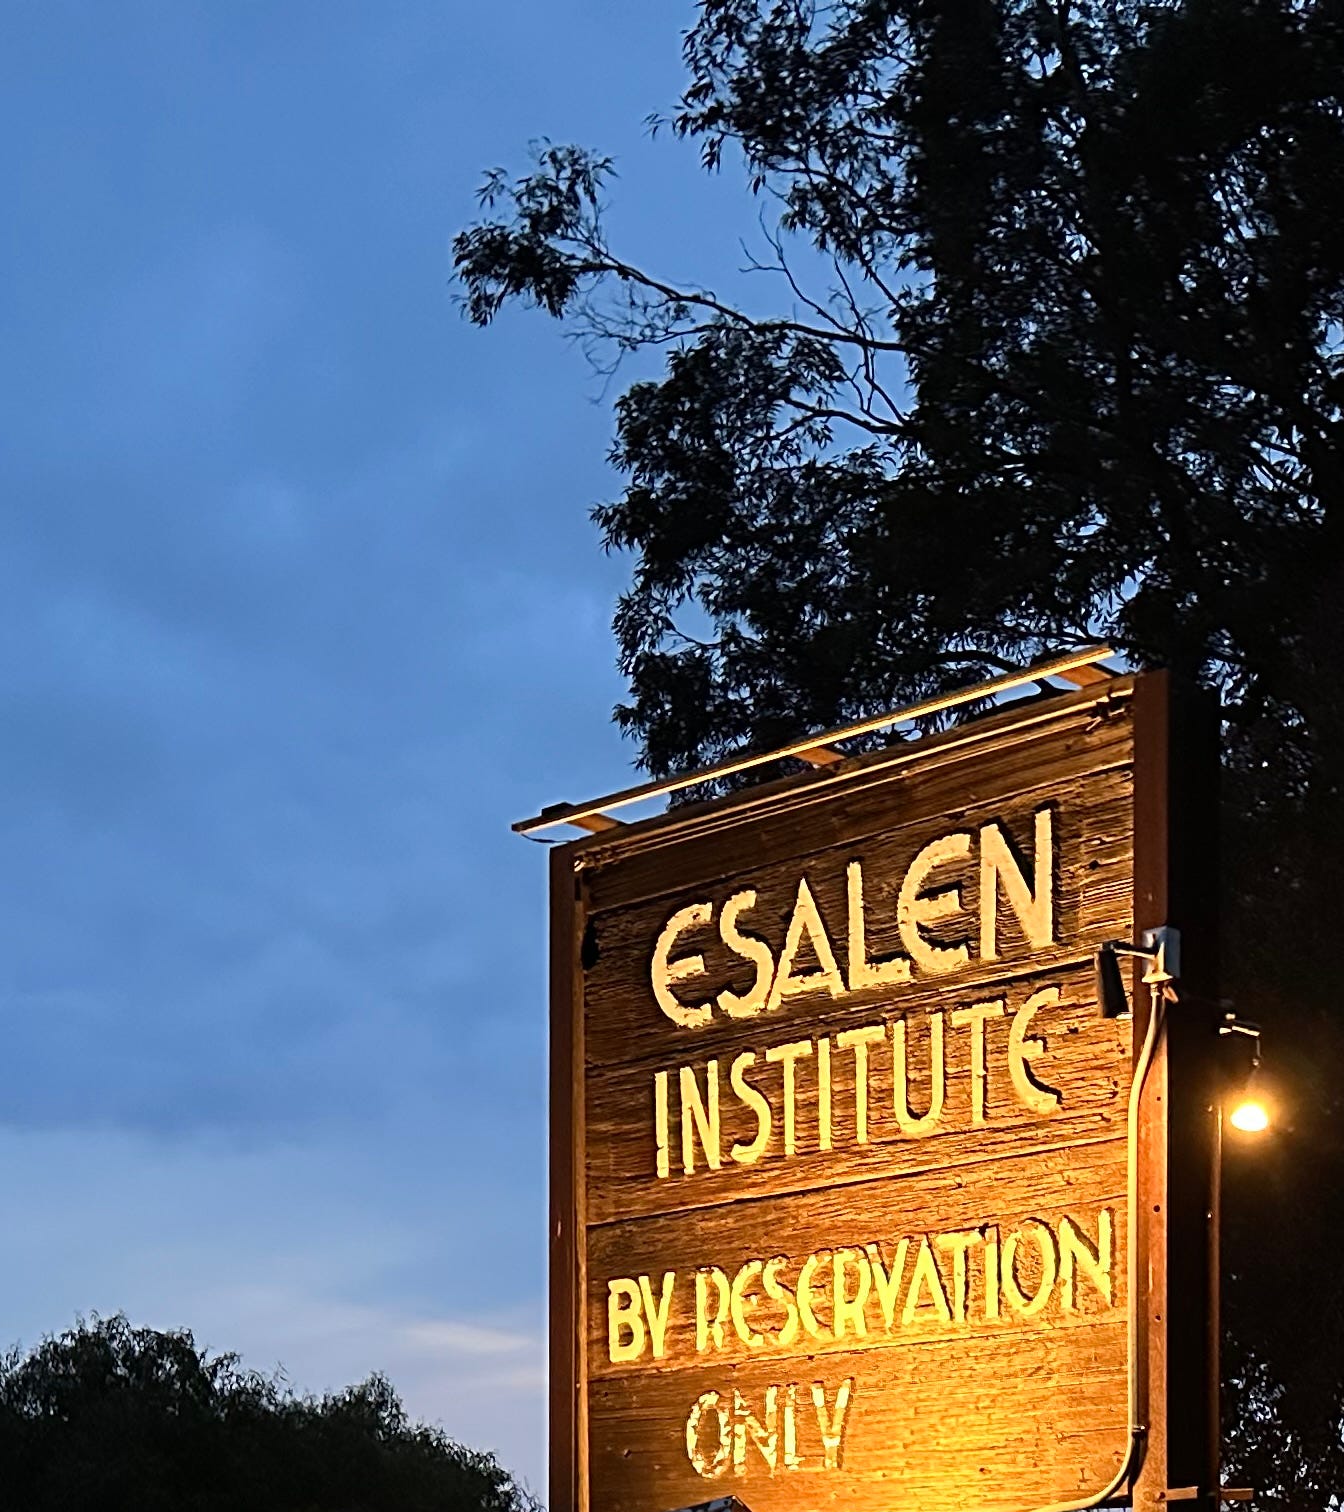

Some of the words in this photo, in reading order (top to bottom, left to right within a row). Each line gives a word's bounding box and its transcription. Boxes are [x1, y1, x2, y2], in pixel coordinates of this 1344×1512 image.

[651, 808, 1058, 1028] ESALEN
[654, 987, 1061, 1179] INSTITUTE
[607, 1271, 676, 1363] BY
[696, 1207, 1114, 1353] RESERVATION
[686, 1376, 854, 1480] ONLY
